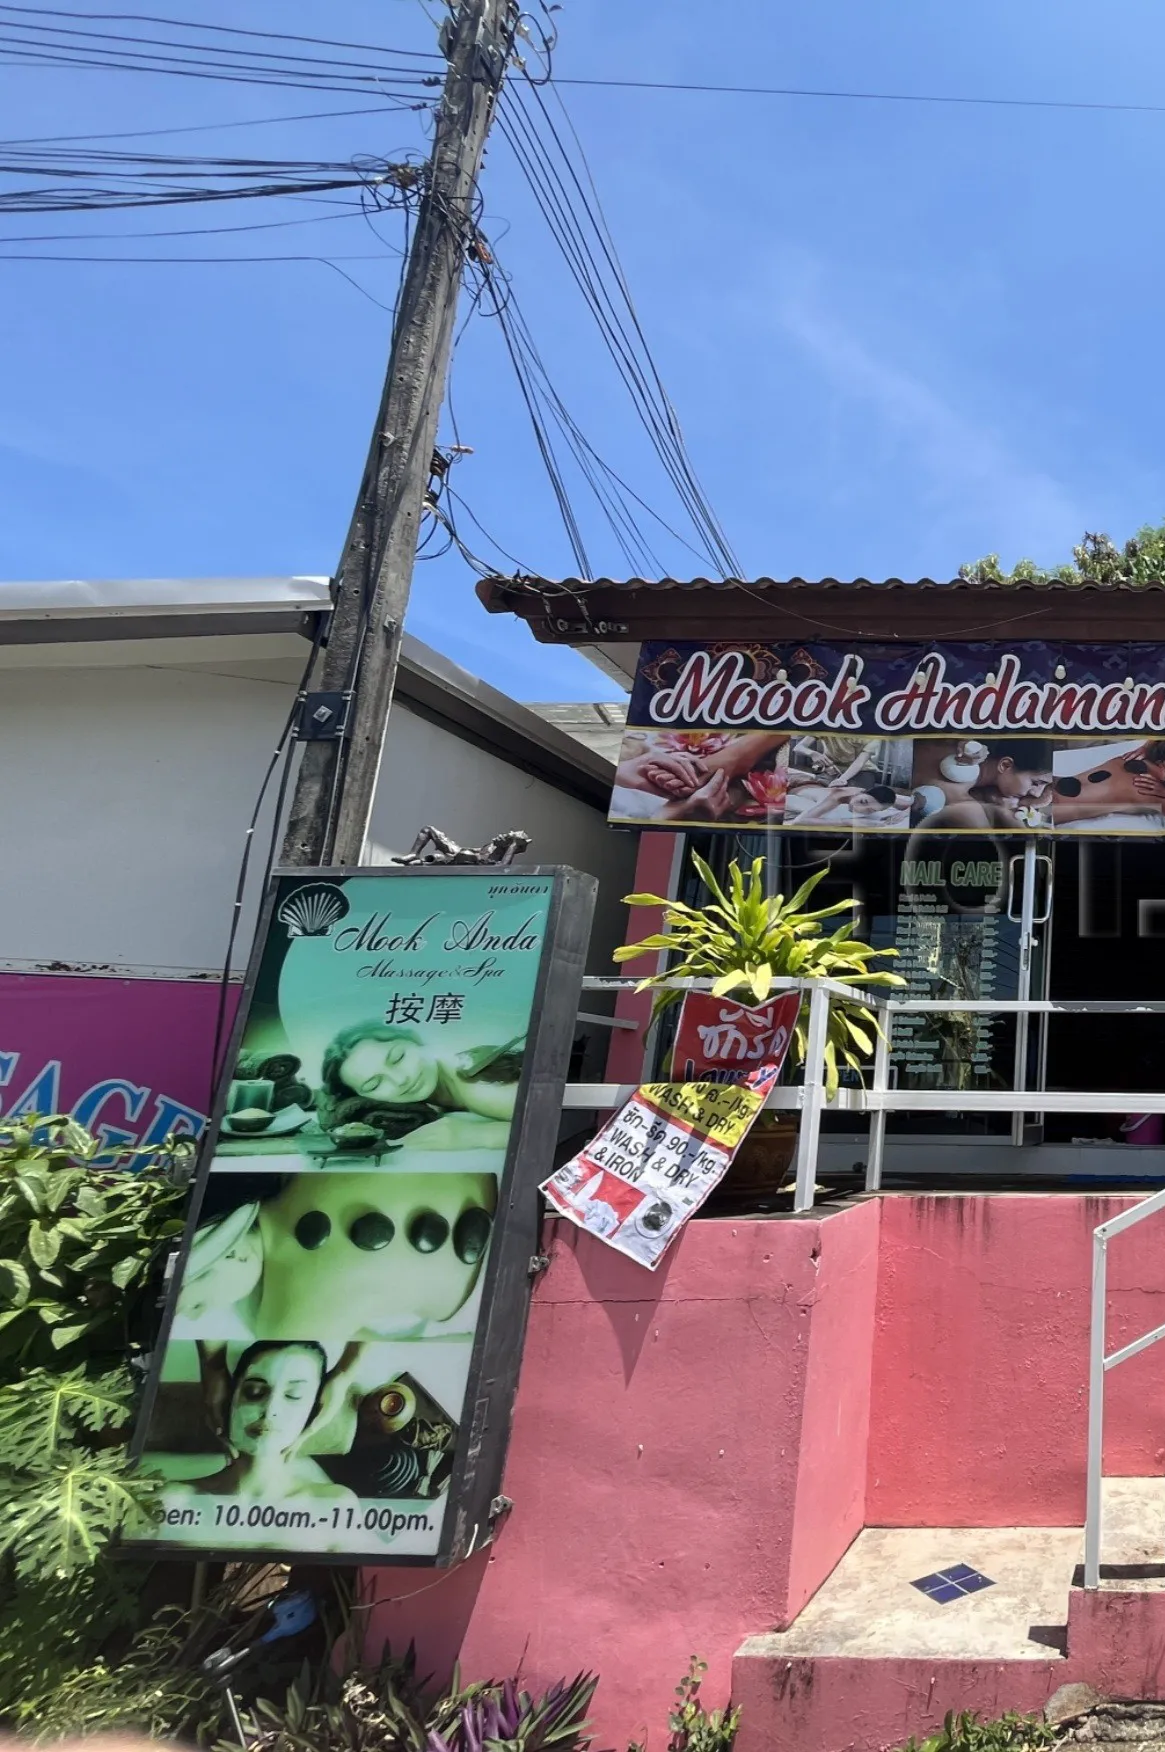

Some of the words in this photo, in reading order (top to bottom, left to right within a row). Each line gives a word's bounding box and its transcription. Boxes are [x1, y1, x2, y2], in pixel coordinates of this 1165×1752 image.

[649, 651, 871, 729] Moook
[900, 861, 947, 887] NAIL
[950, 861, 1003, 887] CARE
[334, 911, 443, 951] Mook
[443, 910, 543, 951] Anda
[385, 992, 466, 1024] 按摩
[0, 1052, 208, 1174] AGE
[649, 1084, 694, 1114] WASH
[692, 1108, 706, 1123] &
[705, 1113, 735, 1135] DRY
[594, 1146, 608, 1161] &
[604, 1152, 645, 1183] IRON
[610, 1127, 656, 1163] WASH
[651, 1157, 666, 1172] &
[664, 1163, 699, 1188] DRY
[152, 1508, 202, 1528] pen:
